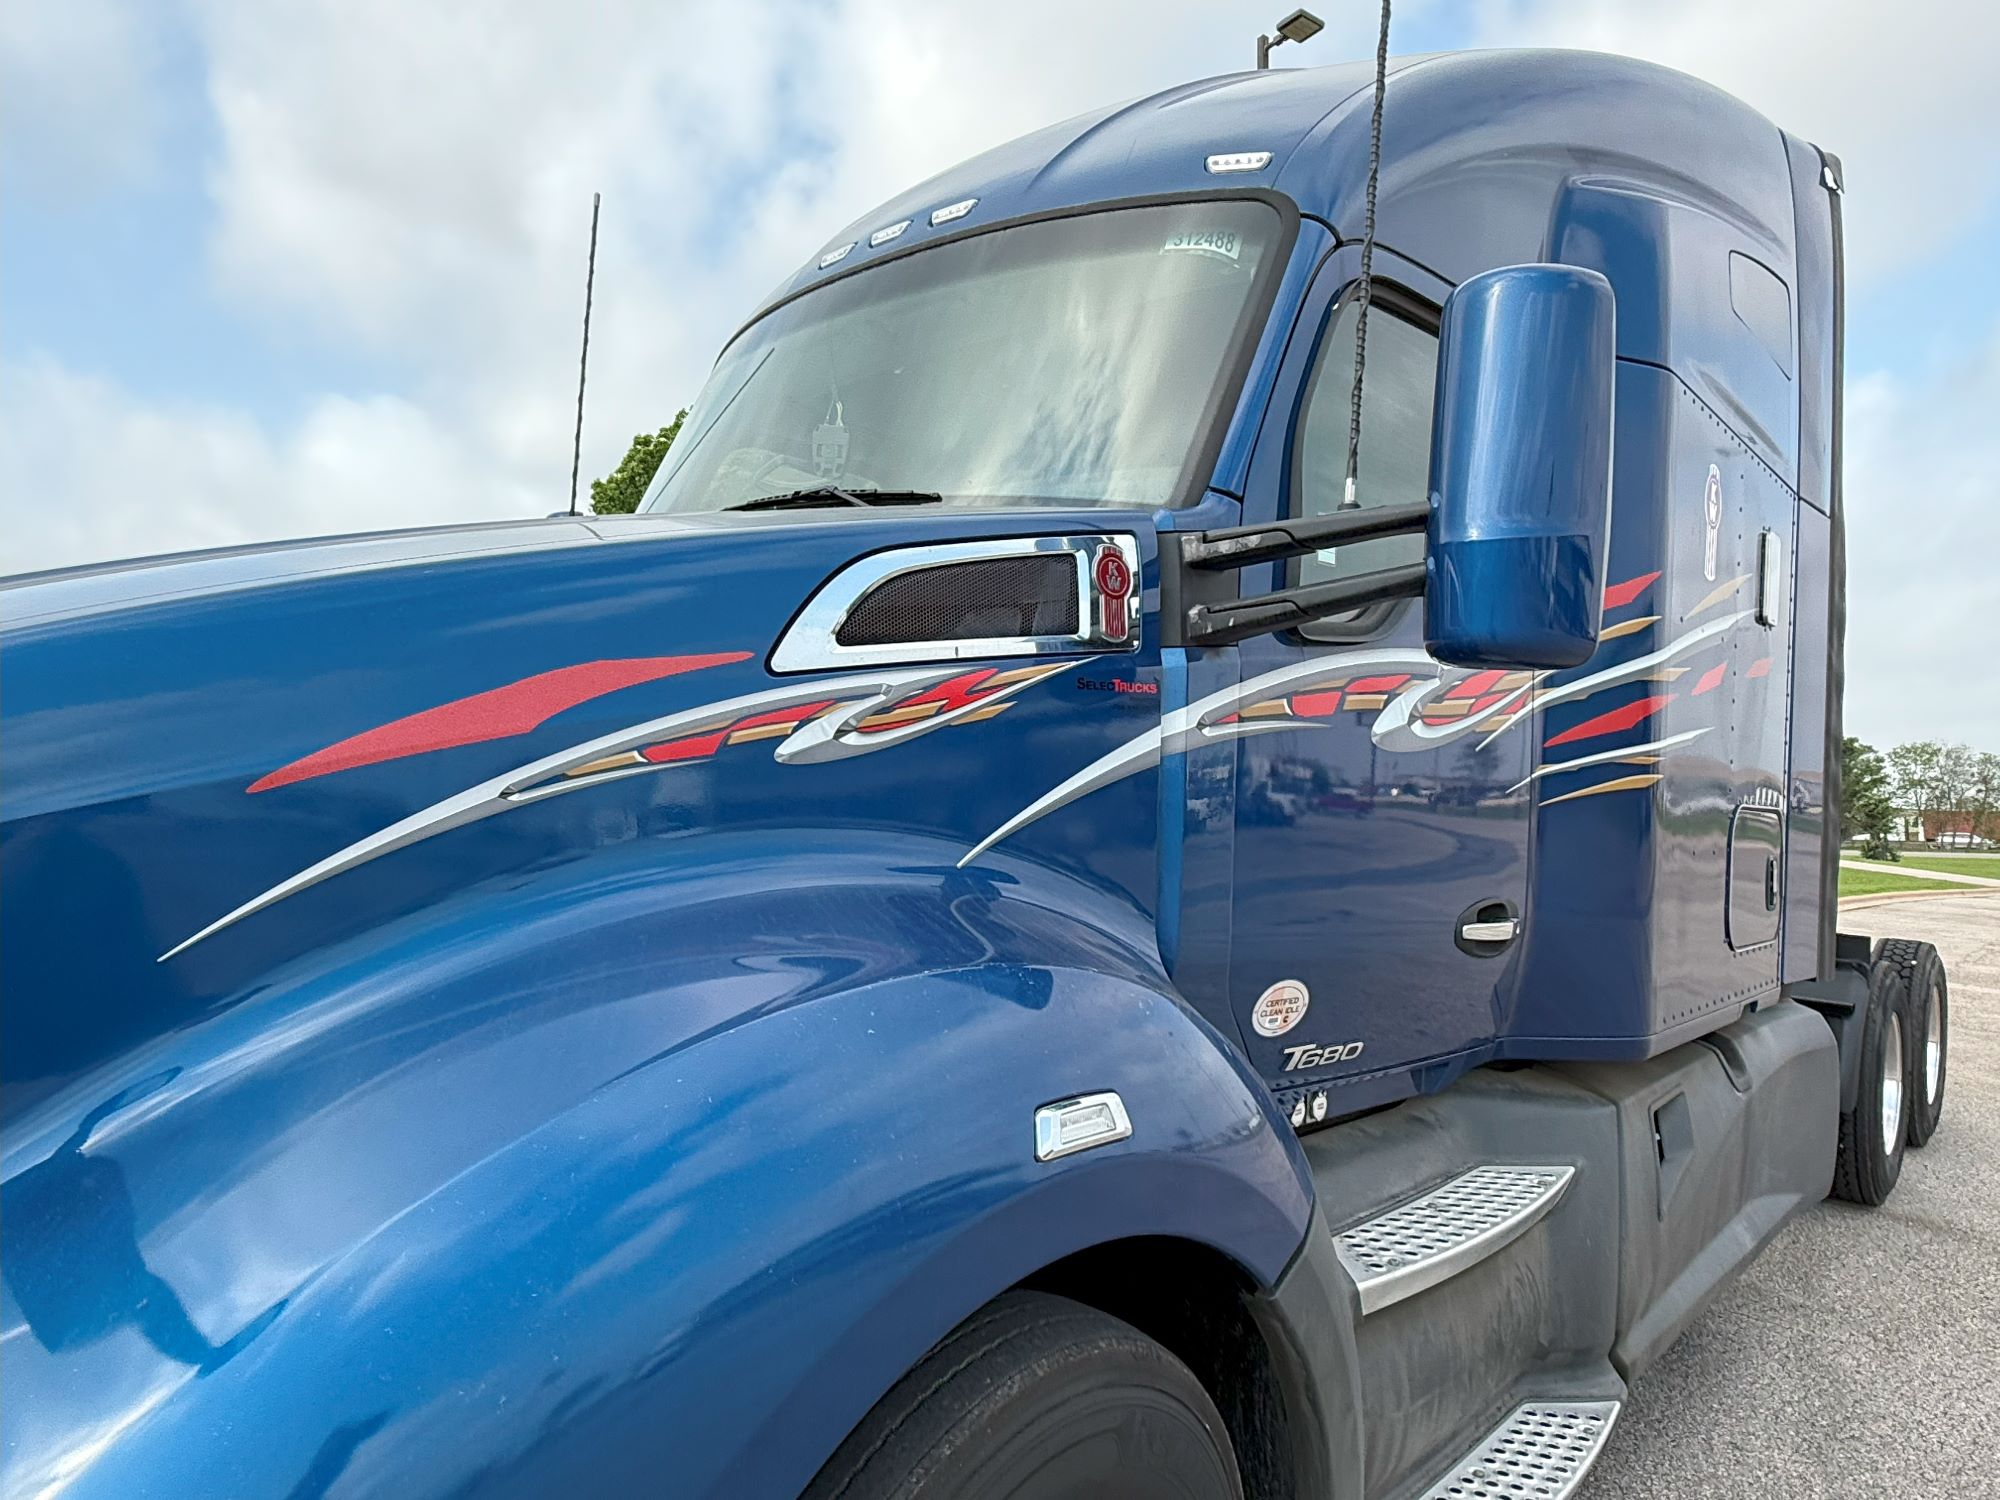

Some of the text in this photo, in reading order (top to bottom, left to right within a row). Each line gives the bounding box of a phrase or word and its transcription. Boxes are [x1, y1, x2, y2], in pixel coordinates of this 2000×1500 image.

[1173, 231, 1236, 253] 312488
[1108, 561, 1118, 577] K
[1106, 575, 1121, 590] W
[1266, 997, 1299, 1007] CERTIFIED
[1260, 1005, 1300, 1018] CLEAN IDLE
[1283, 1041, 1364, 1072] T680
